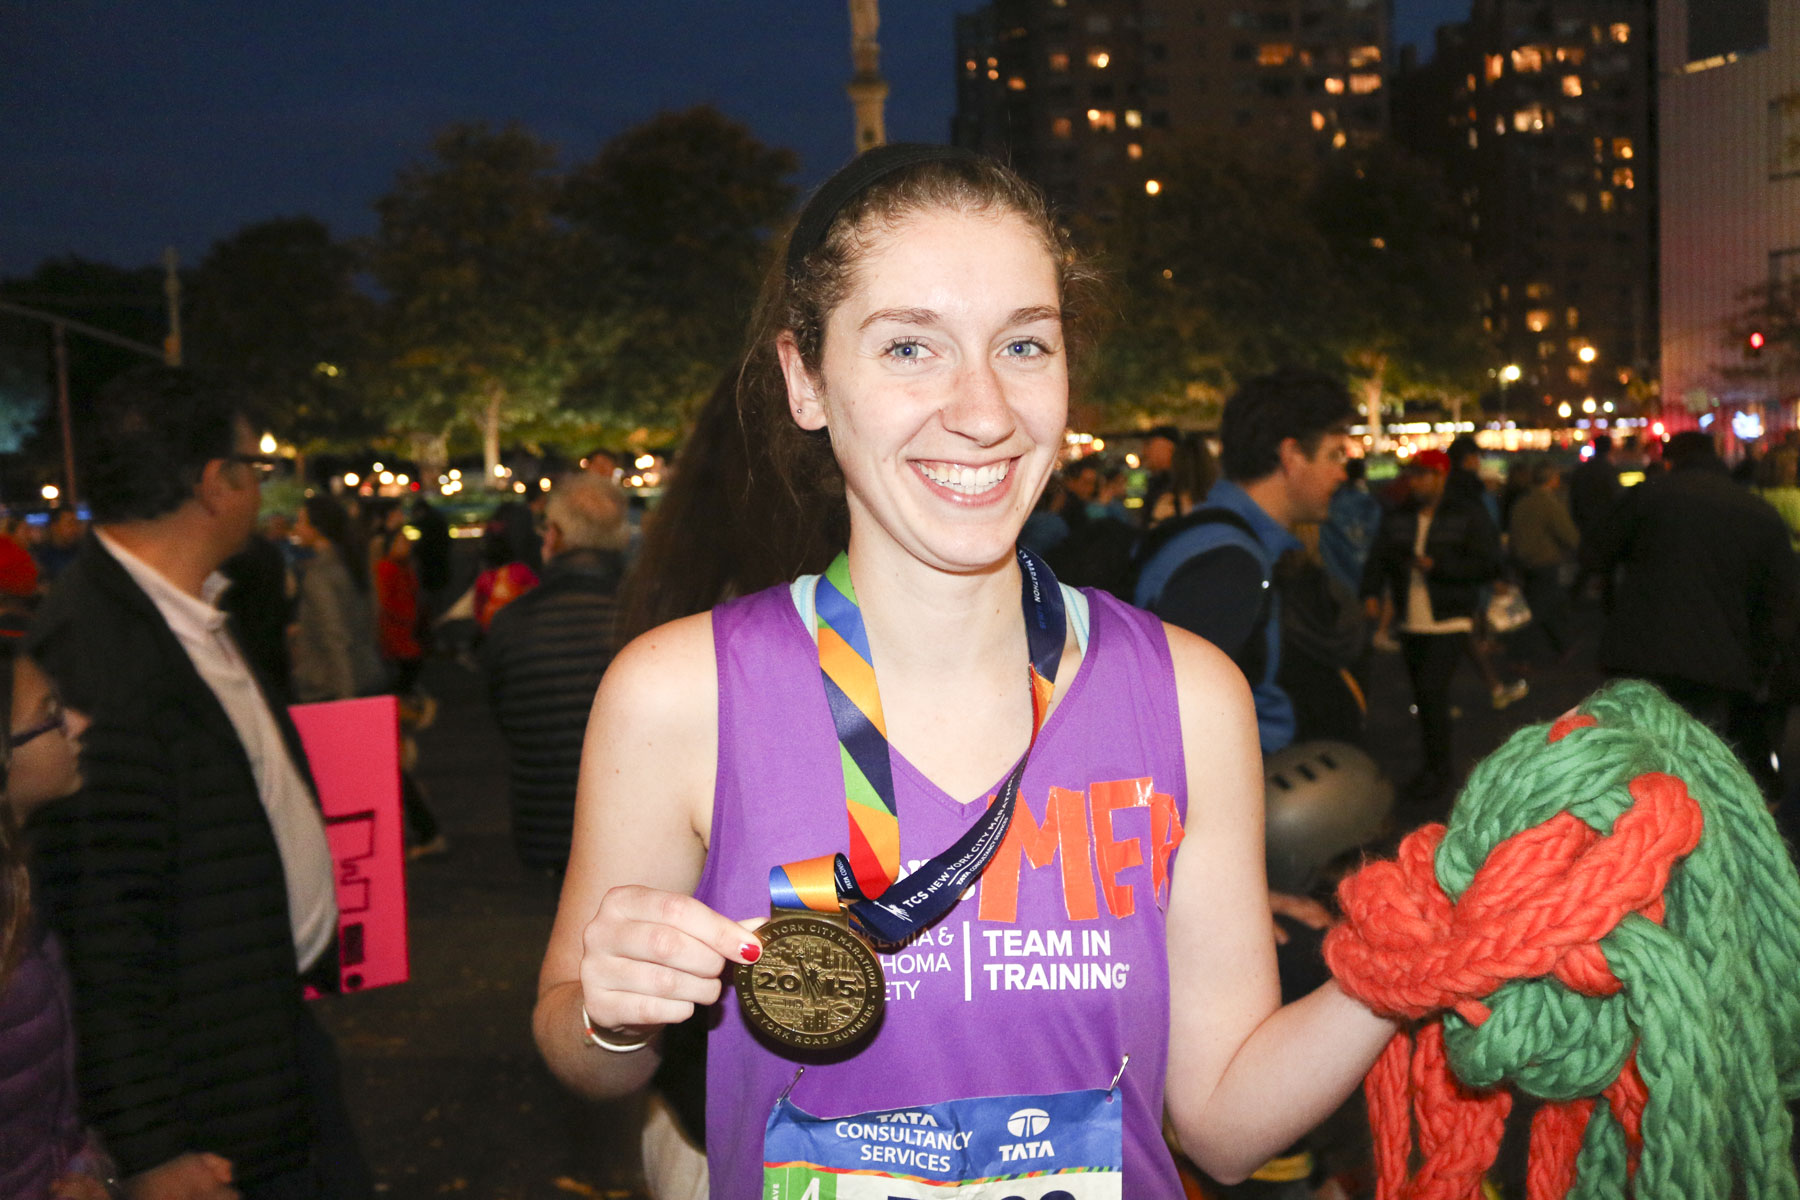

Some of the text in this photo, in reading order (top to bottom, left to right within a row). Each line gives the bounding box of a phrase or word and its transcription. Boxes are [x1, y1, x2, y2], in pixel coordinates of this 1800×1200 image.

[956, 817, 1008, 885] TATA CONSULTANCY SERVICES
[902, 890, 929, 909] TCS
[927, 872, 951, 894] NEW
[947, 853, 974, 873] YORK
[971, 831, 990, 853] CITY
[938, 926, 954, 947] &
[983, 929, 1111, 957] TEAM IN
[773, 924, 805, 937] YORK
[809, 924, 835, 939] CITY
[838, 936, 879, 988] MARATHON
[880, 953, 951, 975] HOMA
[885, 980, 920, 1001] ETY
[983, 962, 1128, 991] TRAINING
[742, 991, 876, 1045] NEW YORK ROAD RUNNERS
[876, 1112, 938, 1127] TATA
[835, 1121, 973, 1151] CONSULTANCY
[860, 1144, 951, 1173] SERVICES
[999, 1140, 1055, 1162] TATA
